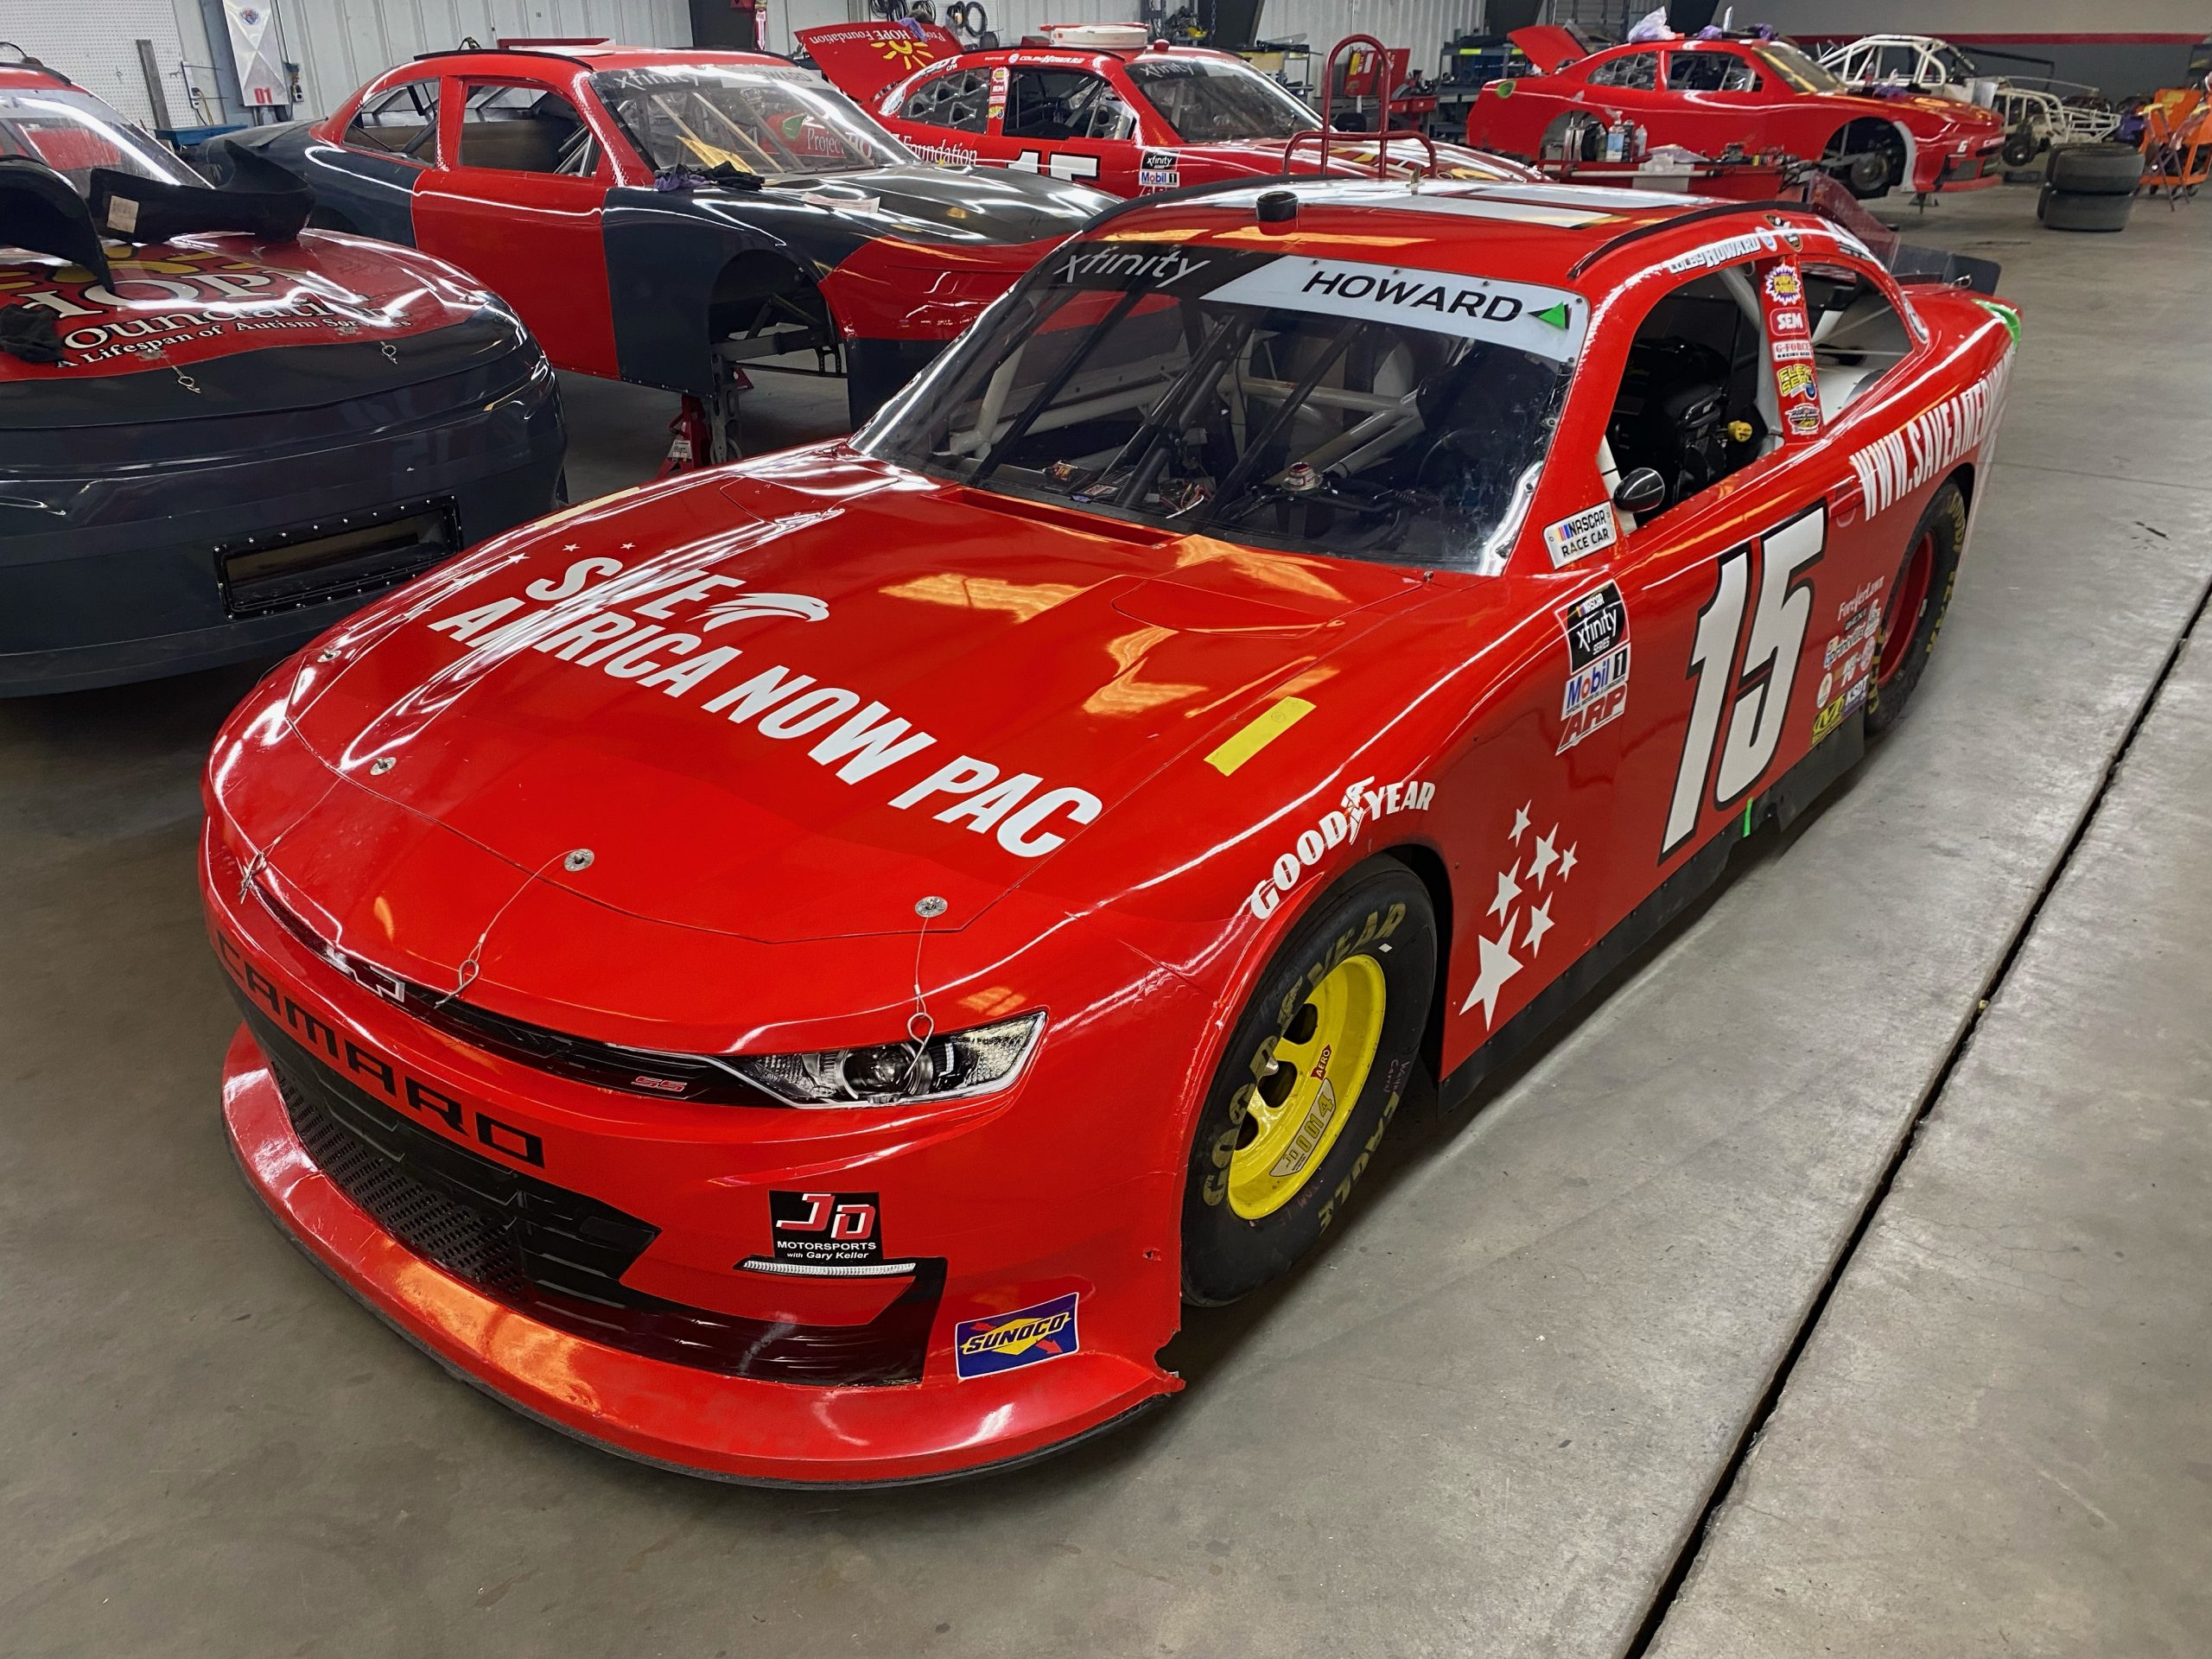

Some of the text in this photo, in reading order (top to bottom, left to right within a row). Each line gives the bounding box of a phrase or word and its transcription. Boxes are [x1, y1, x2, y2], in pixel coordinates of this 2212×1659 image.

[809, 31, 874, 44] Foundation
[873, 29, 910, 40] HOPE
[1141, 61, 1194, 78] xfinity
[254, 87, 273, 104] 01
[1147, 156, 1173, 167] xfinity
[1141, 172, 1166, 183] Mobil
[1704, 236, 1761, 267] HOWARD
[1053, 248, 1211, 288] xfinity
[1301, 270, 1523, 323] HOWARD
[1777, 313, 1803, 329] SEM
[57, 359, 79, 368] A
[80, 334, 194, 363] Lifespan
[199, 325, 222, 337] of
[237, 318, 320, 331] Autism
[1779, 364, 1812, 381] FLEX
[1782, 375, 1813, 395] SEAL
[1568, 510, 1606, 537] NASCAR
[1561, 528, 1609, 556] RACE CAR
[1584, 593, 1605, 613] NASCAR
[1577, 608, 1617, 652] xfinity
[1592, 636, 1610, 655] SERIES
[1567, 658, 1610, 709] Mobil
[1661, 499, 1827, 859] 15
[1560, 683, 1626, 746] ARP
[701, 665, 937, 785] NOW
[888, 755, 1103, 856] PAC
[1251, 777, 1435, 919] GOODYEAR
[218, 931, 546, 1169] CAMARO
[1316, 1048, 1331, 1077] AERO
[631, 1076, 688, 1092] SS
[1319, 1091, 1400, 1236] EAGLE
[776, 1193, 875, 1240] JD
[777, 1241, 877, 1250] MOTORSPORTS
[806, 1251, 833, 1261] Gary
[965, 1313, 1068, 1351] SUNOCO
